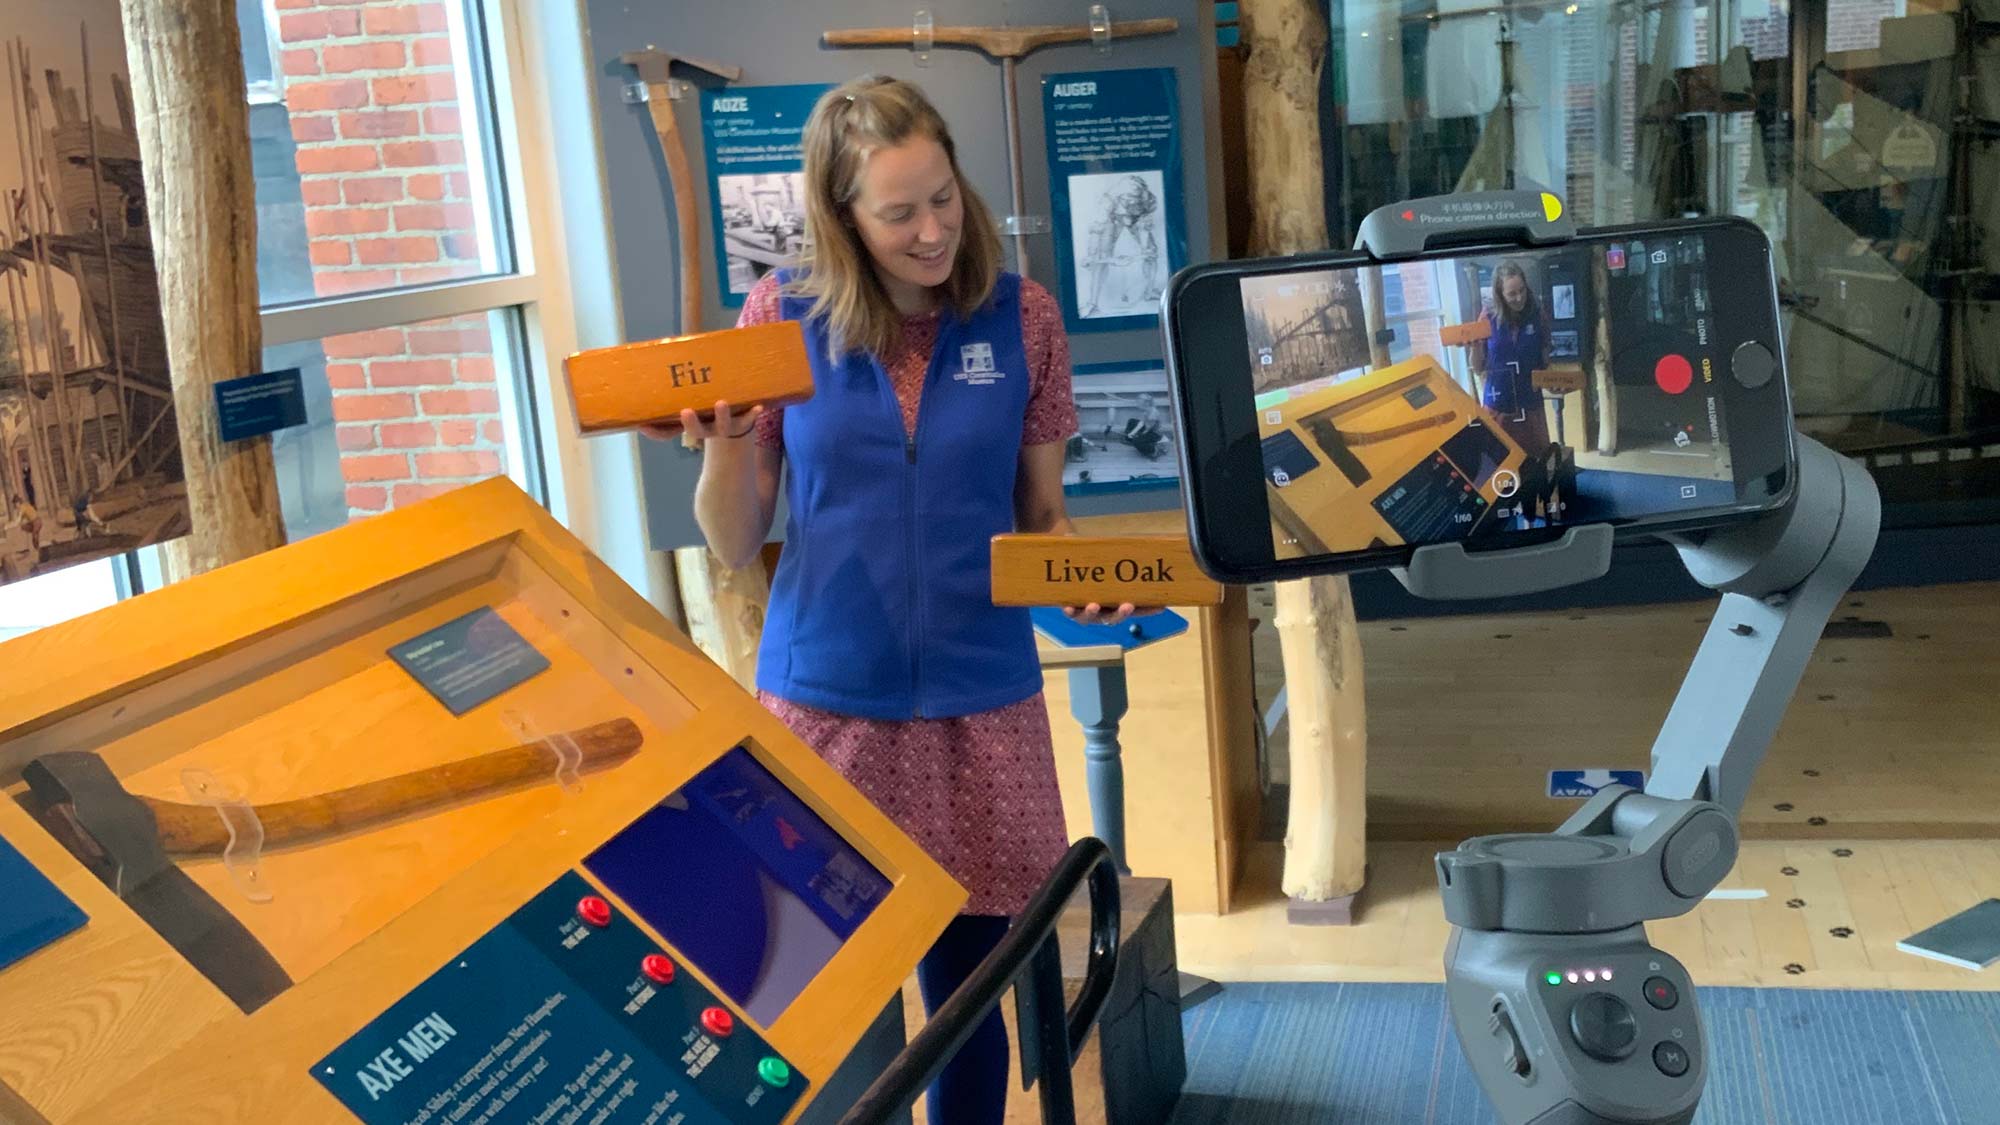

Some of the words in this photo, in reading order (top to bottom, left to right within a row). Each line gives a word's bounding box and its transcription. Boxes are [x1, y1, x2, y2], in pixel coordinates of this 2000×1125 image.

[1053, 82, 1097, 97] AUGER
[712, 97, 749, 112] ADZE
[1420, 214, 1453, 224] Phone
[1456, 213, 1494, 222] camera
[1496, 210, 1541, 221] direction
[1697, 318, 1707, 345] PHOTO
[668, 362, 712, 388] Fir
[1702, 358, 1712, 384] VIDEO
[1454, 513, 1472, 524] 1/60
[1044, 559, 1104, 583] Live
[1114, 558, 1175, 582] Oak
[356, 1046, 414, 1100] AXE
[398, 1012, 457, 1064] MEN
[460, 1052, 496, 1086] carpenter
[491, 1036, 514, 1058] from
[508, 1023, 530, 1041] New
[1666, 1052, 1679, 1063] M
[450, 1092, 482, 1122] timbers
[478, 1074, 500, 1096] used
[496, 1069, 508, 1082] in
[503, 1030, 552, 1072] Constitution's
[564, 1082, 580, 1095] To
[576, 1072, 590, 1090] get
[585, 1062, 601, 1078] the
[485, 1097, 506, 1118] with
[501, 1086, 520, 1102] this
[516, 1070, 538, 1089] very
[590, 1083, 606, 1099] the
